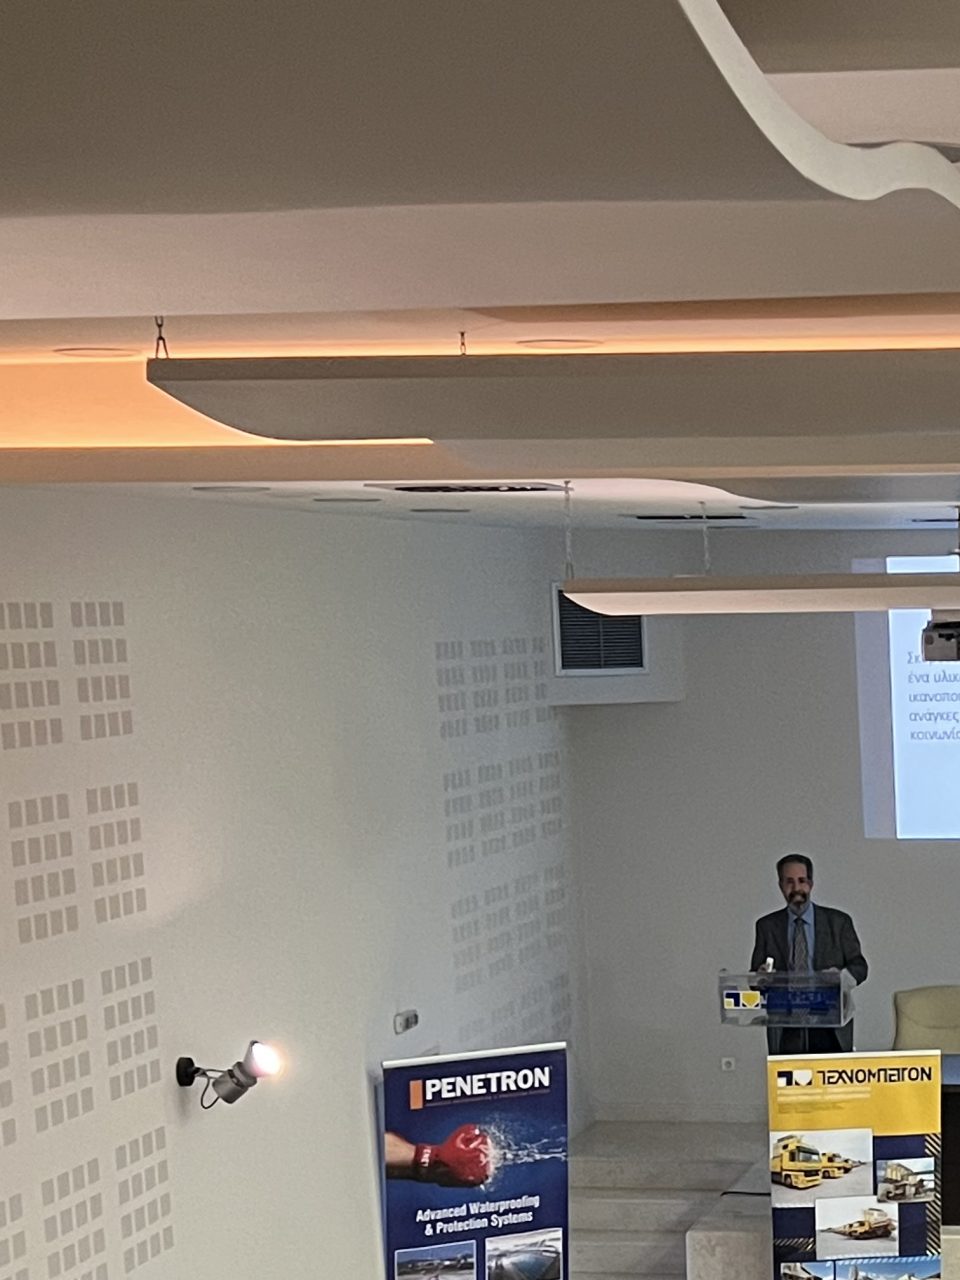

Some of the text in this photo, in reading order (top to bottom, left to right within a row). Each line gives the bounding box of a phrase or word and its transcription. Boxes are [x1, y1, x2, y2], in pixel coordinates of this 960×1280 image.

[907, 670, 930, 683] ένα
[908, 708, 960, 724] ανάγκες
[425, 1067, 550, 1101] PENETRON
[416, 1195, 540, 1223] Advanced Waterproofing
[424, 1211, 534, 1236] & Protection Systems
